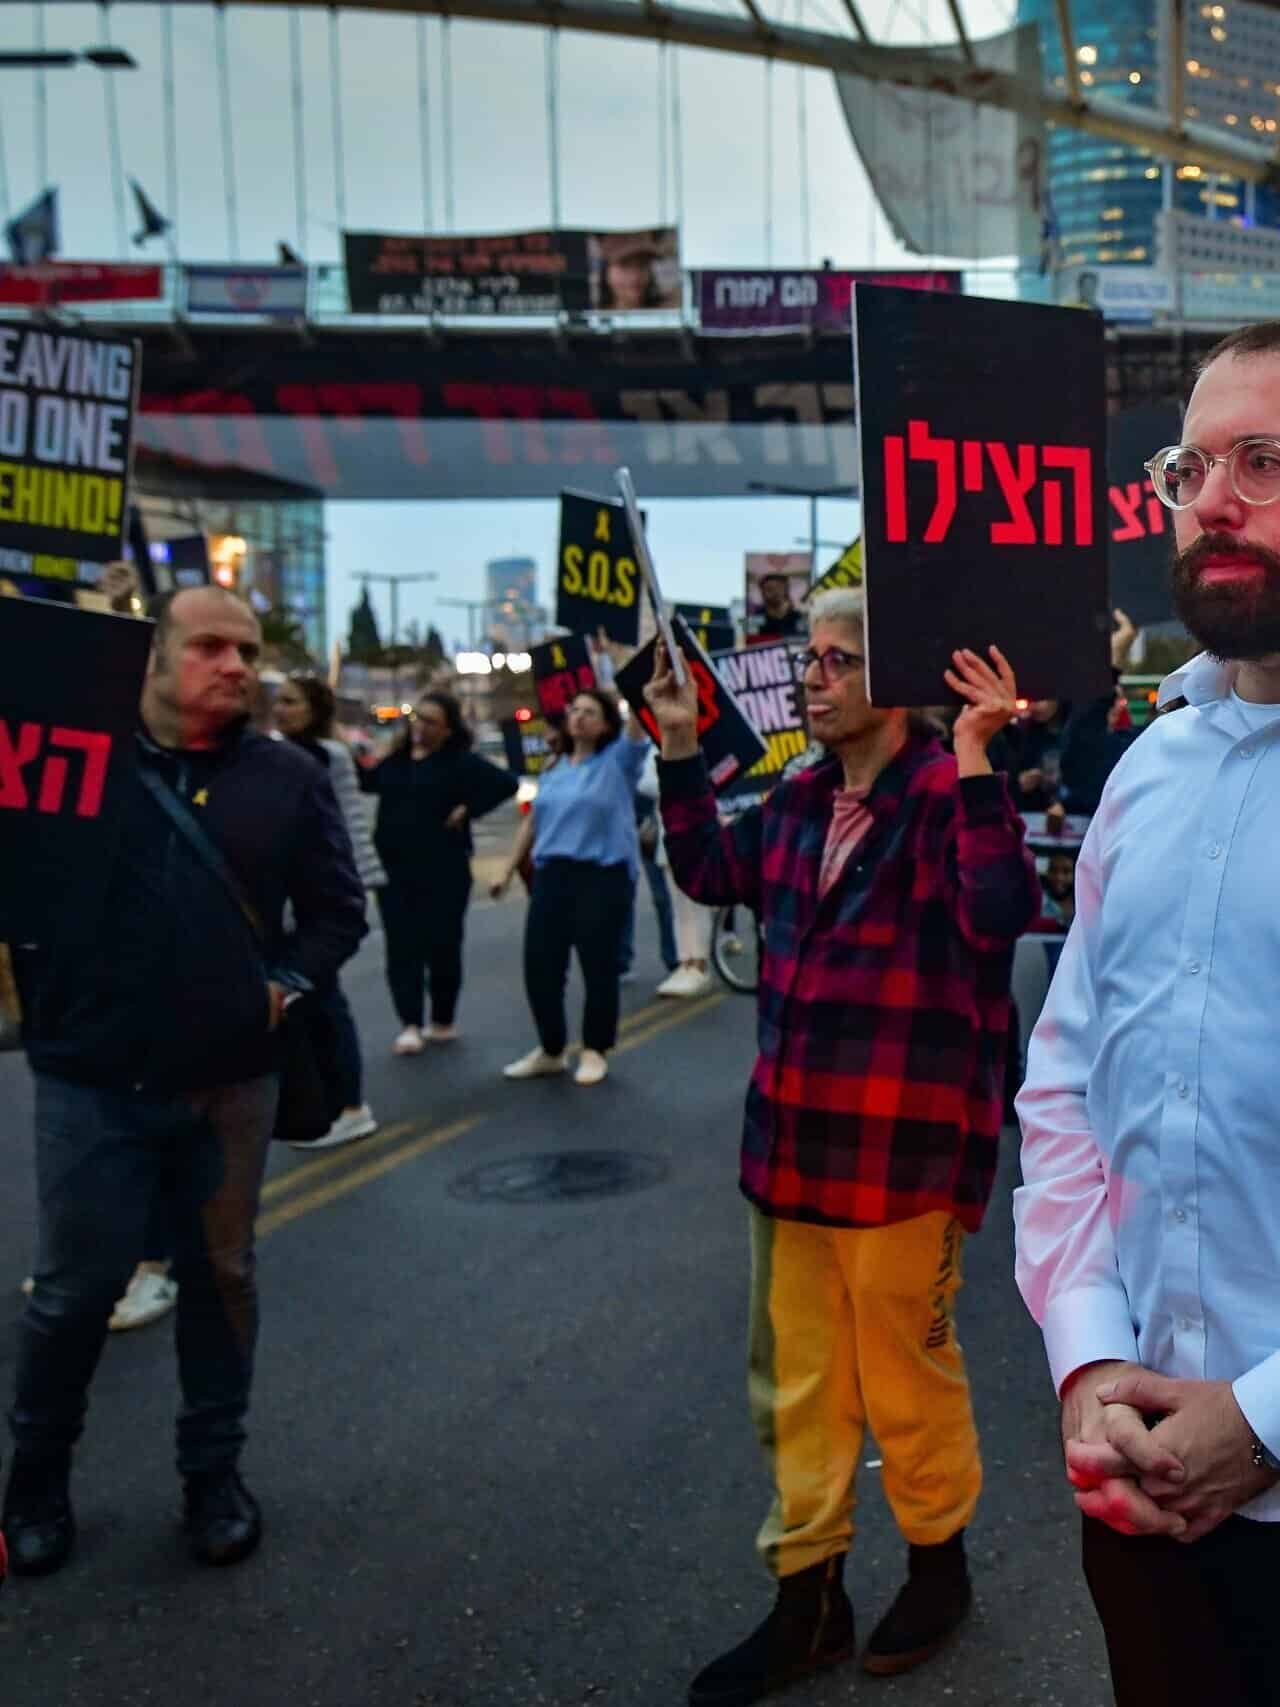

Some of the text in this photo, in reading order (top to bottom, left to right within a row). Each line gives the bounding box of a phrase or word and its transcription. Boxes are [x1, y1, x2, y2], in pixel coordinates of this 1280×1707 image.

[0, 327, 132, 399] EAVING
[0, 390, 29, 457] O
[35, 395, 129, 472] ONE
[0, 462, 123, 537] EHIND!
[882, 420, 1094, 547] הצילו
[562, 544, 638, 608] S.O.S
[717, 646, 793, 691] AVING
